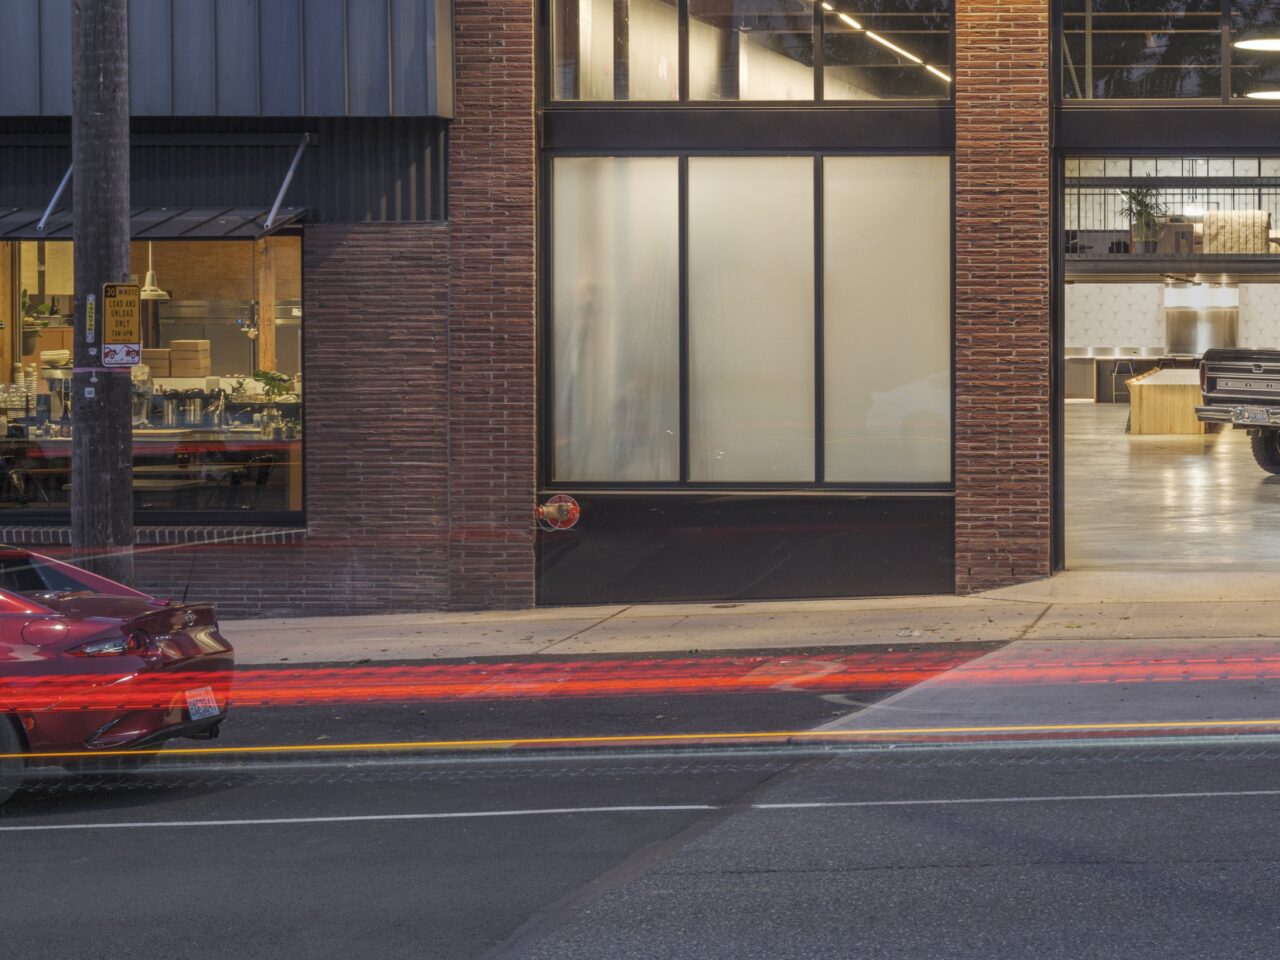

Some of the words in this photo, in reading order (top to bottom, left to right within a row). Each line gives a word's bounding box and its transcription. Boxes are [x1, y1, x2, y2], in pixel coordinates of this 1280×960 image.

[109, 300, 123, 308] LOAD
[126, 300, 136, 308] AND
[111, 309, 133, 317] UNLOAD
[115, 320, 129, 328] ONLY
